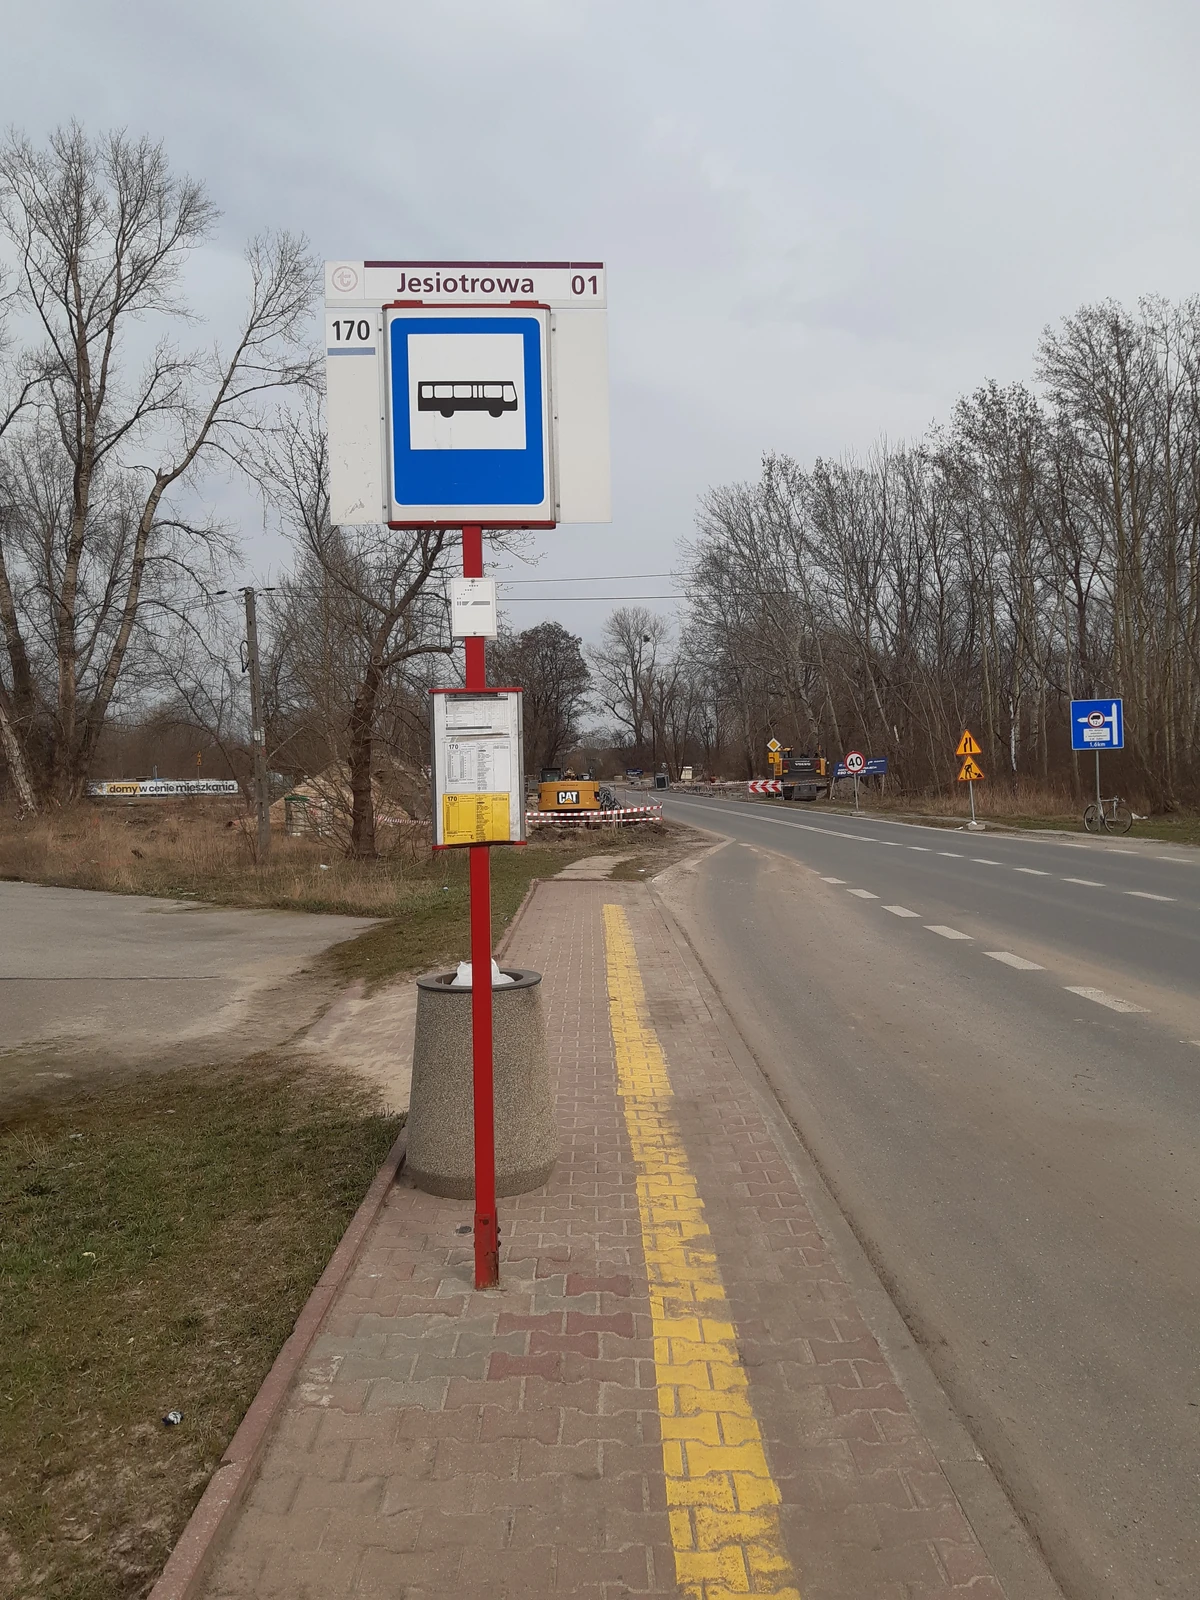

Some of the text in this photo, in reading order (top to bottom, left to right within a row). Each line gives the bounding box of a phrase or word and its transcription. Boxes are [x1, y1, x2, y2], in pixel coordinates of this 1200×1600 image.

[397, 272, 534, 293] Jesiotrowa
[571, 275, 598, 295] 01
[332, 320, 370, 341] 170
[848, 756, 863, 768] 40
[109, 785, 138, 795] domy
[148, 783, 175, 792] cenie
[176, 782, 235, 792] mieszkania
[558, 791, 578, 804] CAT
